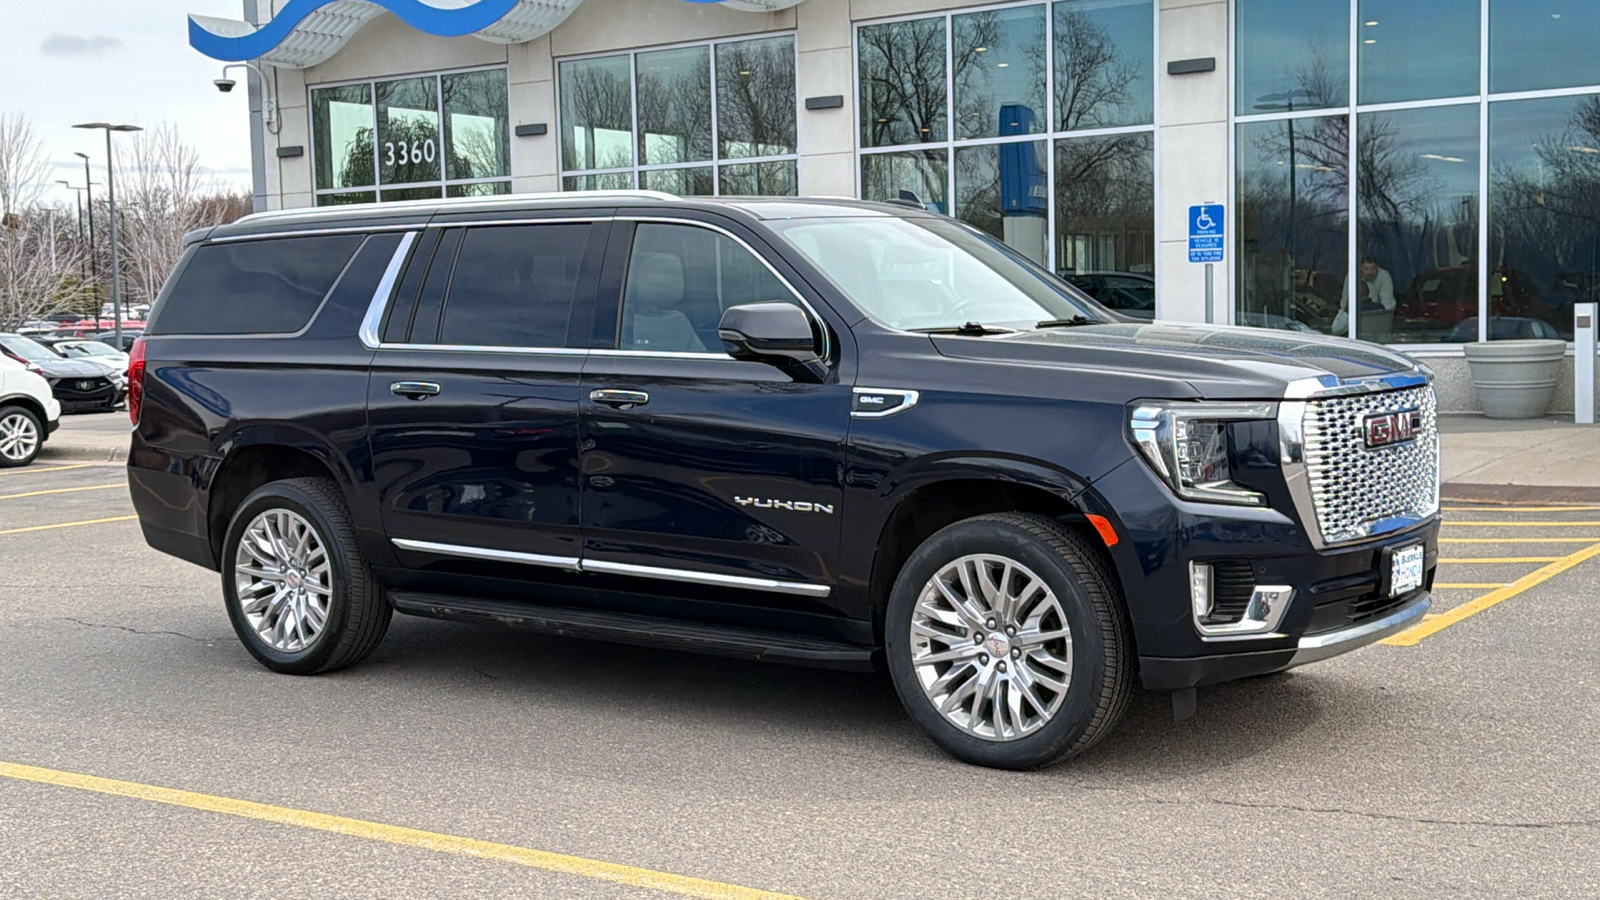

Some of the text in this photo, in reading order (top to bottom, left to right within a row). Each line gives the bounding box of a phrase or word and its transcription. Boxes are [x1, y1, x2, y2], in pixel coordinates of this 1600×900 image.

[385, 138, 436, 166] 3360
[860, 396, 884, 404] GMC
[1366, 411, 1421, 446] GMC
[734, 496, 834, 514] YUKON
[1401, 563, 1421, 580] HONDA
